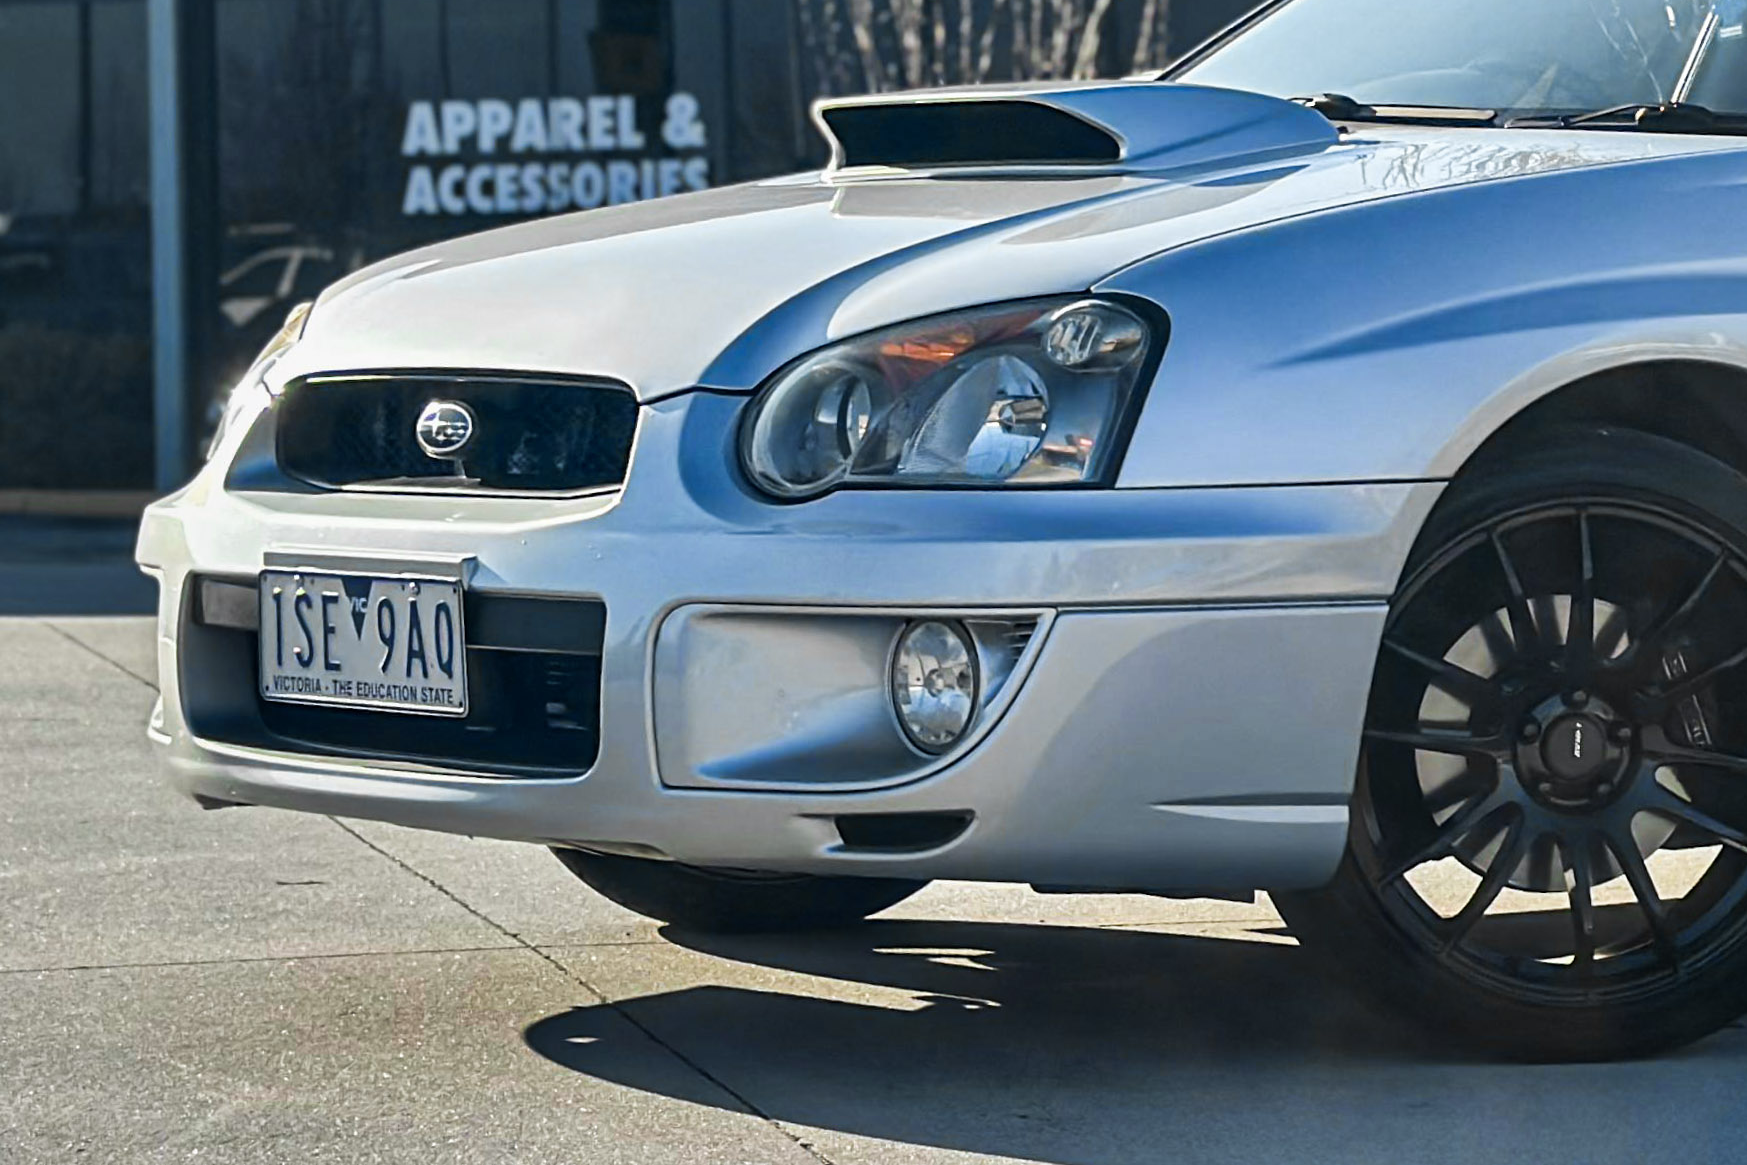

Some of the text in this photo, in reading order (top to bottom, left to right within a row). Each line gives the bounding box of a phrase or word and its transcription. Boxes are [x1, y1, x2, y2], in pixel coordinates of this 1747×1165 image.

[402, 92, 706, 156] APPAREL &
[402, 157, 708, 215] ACCESSORIES
[273, 587, 454, 679] 1SE 9AQ
[273, 675, 322, 693] VICTORIA
[332, 679, 353, 697] THE
[356, 681, 418, 702] EDUCATION
[421, 687, 454, 704] STATE
